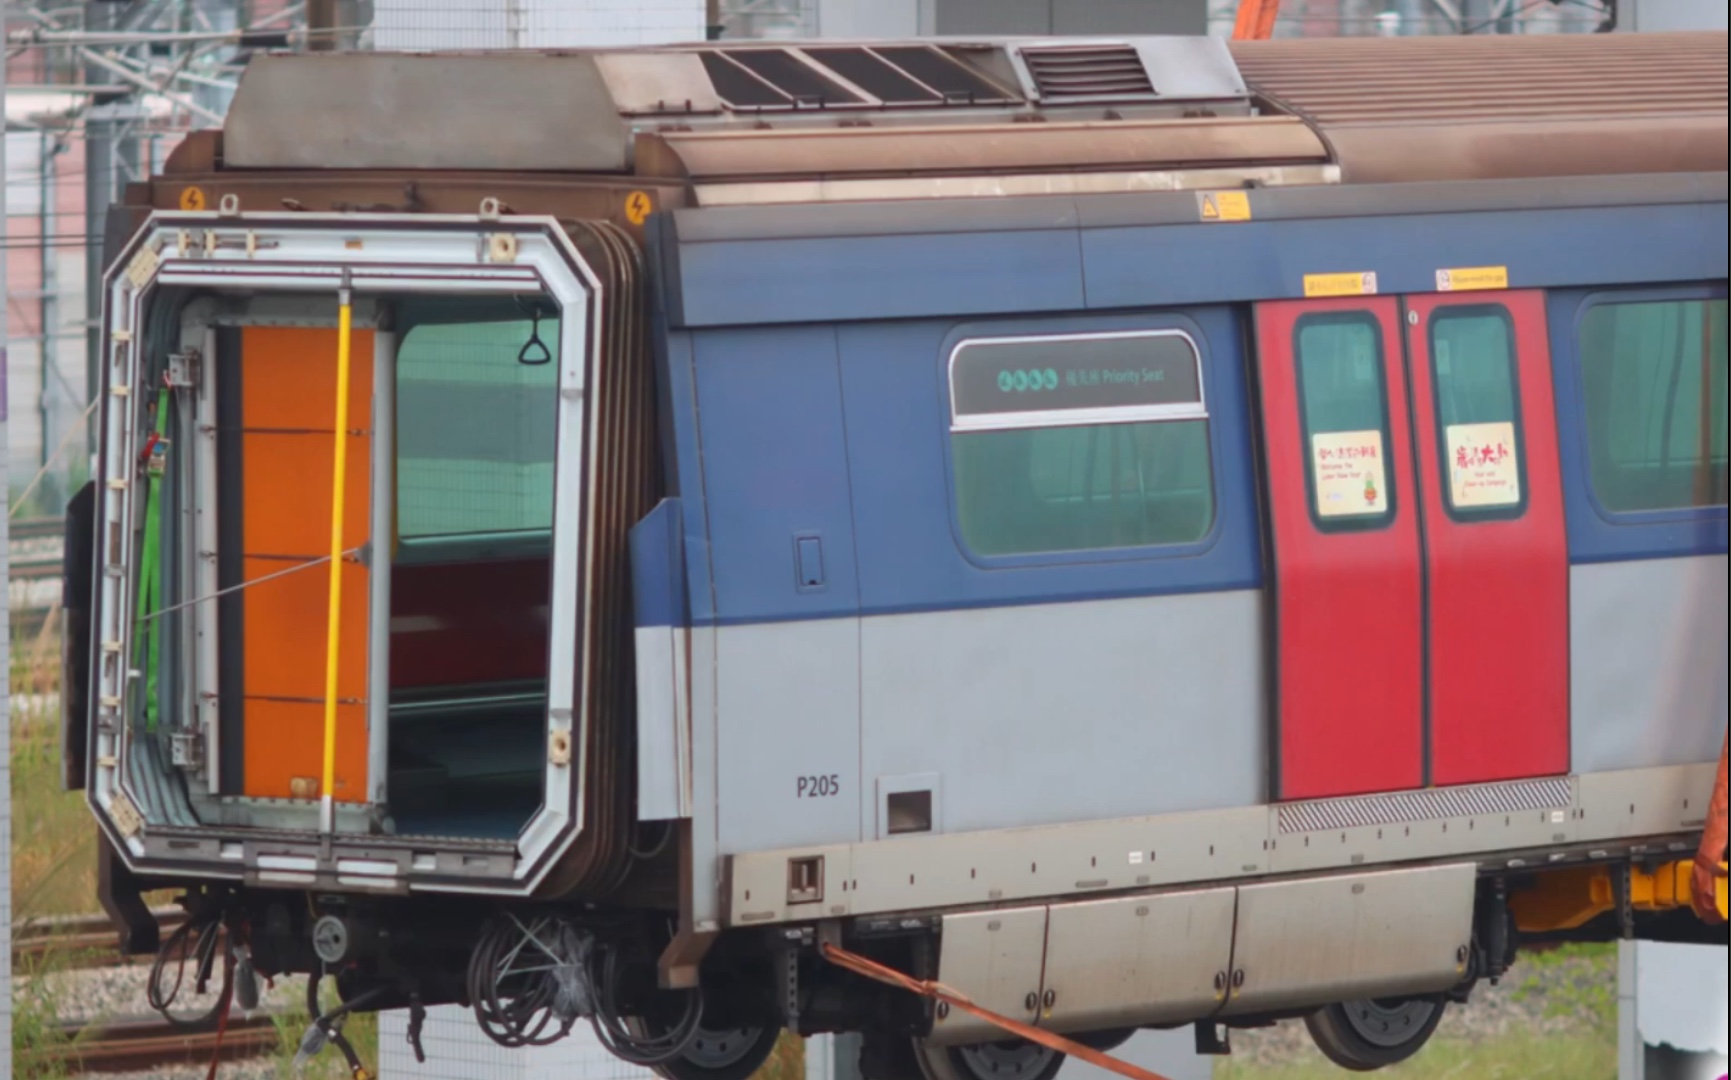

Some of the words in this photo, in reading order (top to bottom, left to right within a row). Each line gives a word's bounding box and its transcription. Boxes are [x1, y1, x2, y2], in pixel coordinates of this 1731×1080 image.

[1103, 368, 1139, 386] Priority
[1141, 367, 1164, 382] Seat
[797, 774, 839, 798] P205
